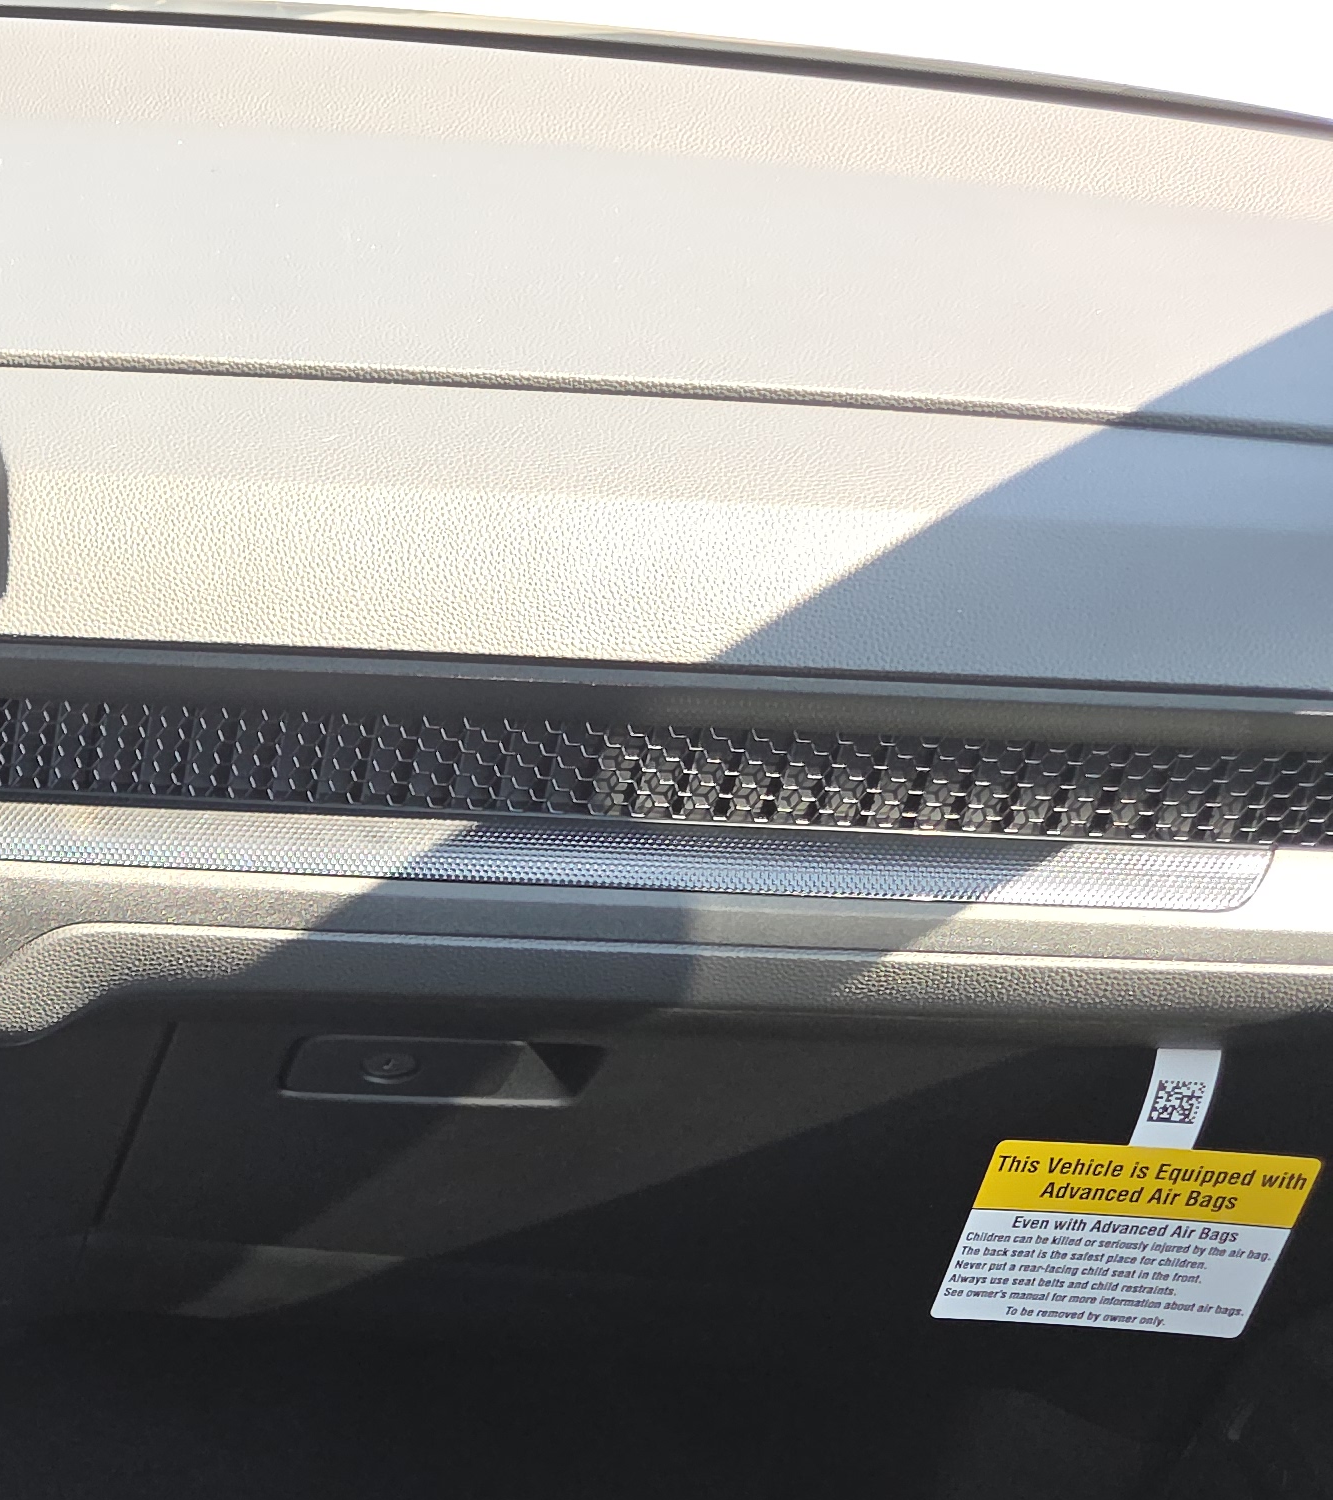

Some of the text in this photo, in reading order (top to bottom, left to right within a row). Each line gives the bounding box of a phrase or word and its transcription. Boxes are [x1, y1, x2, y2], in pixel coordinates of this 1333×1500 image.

[998, 1155, 1307, 1191] This Vehicle is Equipped with
[1039, 1182, 1238, 1213] Advanced Air Bags
[1011, 1216, 1239, 1244] Even with Advanced Air Bags
[961, 1246, 1208, 1270] The back seat is the safest place for children.
[966, 1232, 1272, 1262] Children can be killed or seriously injured by the air bag.
[948, 1273, 1177, 1296] Always use seat belts and child restraints.
[954, 1260, 987, 1270] Never
[988, 1262, 1008, 1272] put
[1018, 1263, 1079, 1276] rear-facing
[1081, 1267, 1110, 1277] child
[1111, 1269, 1136, 1278] seat
[1138, 1269, 1150, 1279] in
[1151, 1271, 1170, 1281] the
[1171, 1273, 1202, 1284] front.
[943, 1287, 1244, 1317] See owner's manual for more information about air bags.
[1005, 1306, 1165, 1327] To be removed by owner only.
